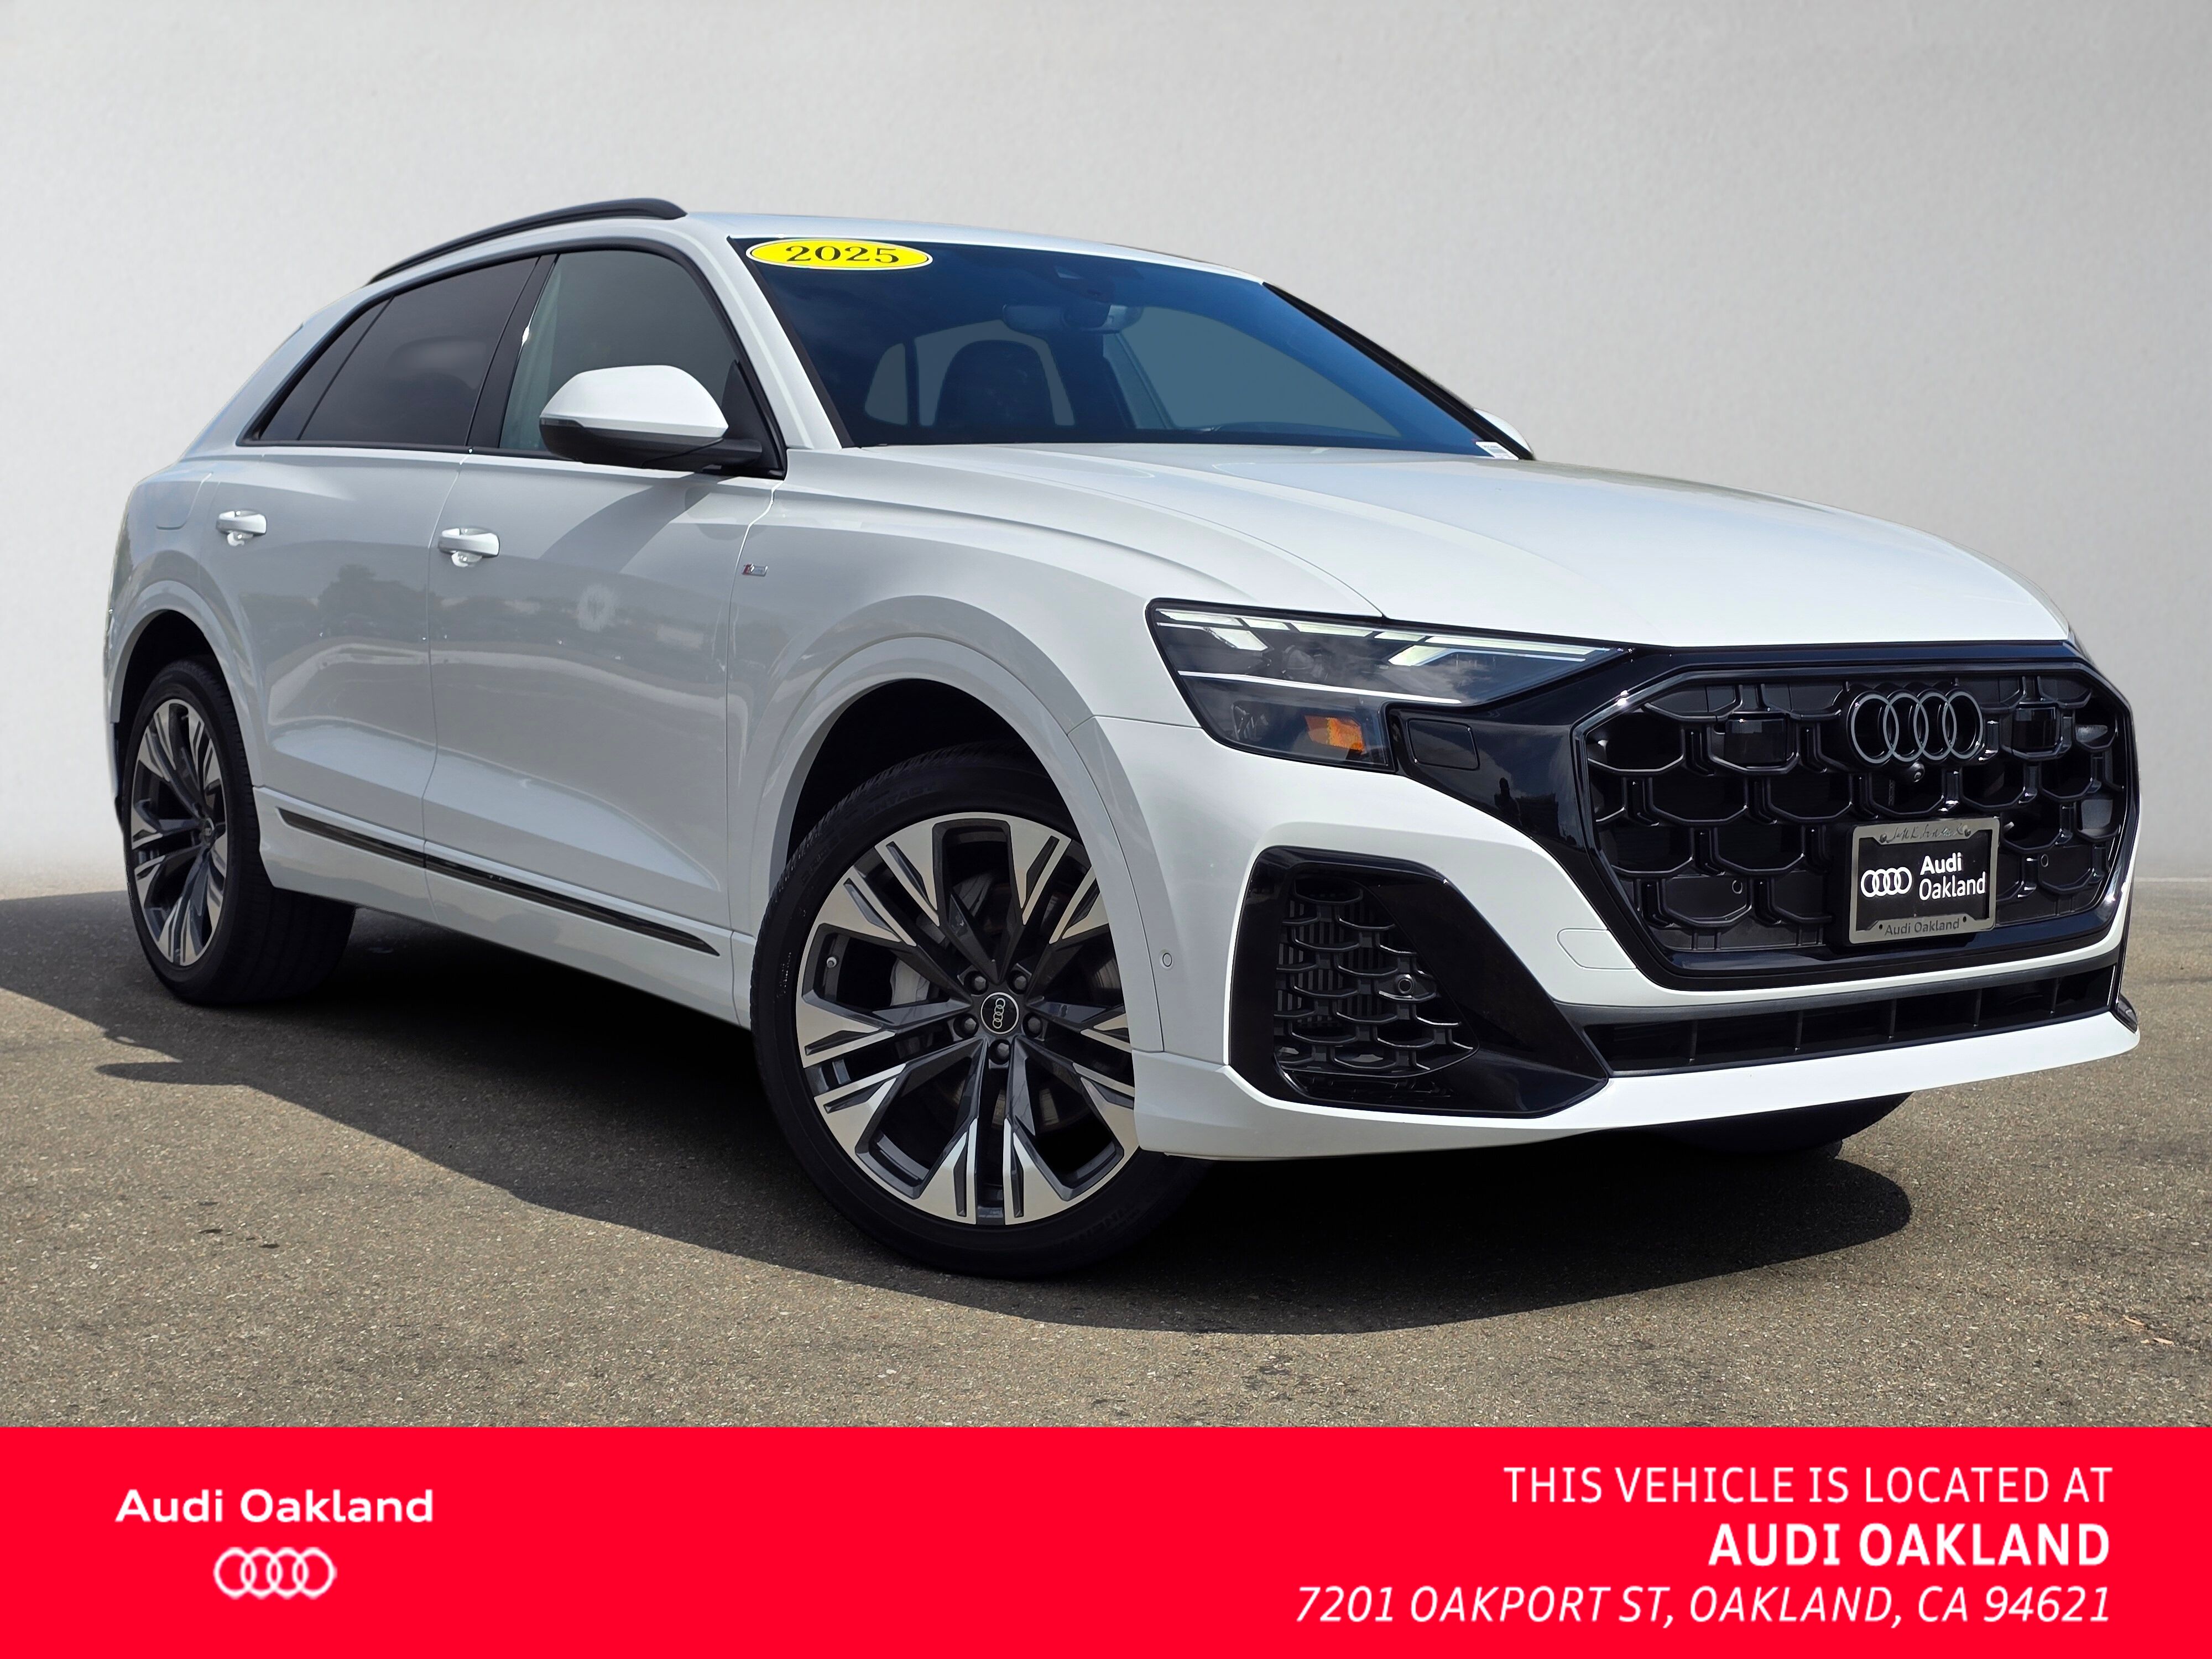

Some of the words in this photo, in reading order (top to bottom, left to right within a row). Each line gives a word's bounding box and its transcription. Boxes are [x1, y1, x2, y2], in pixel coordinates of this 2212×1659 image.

[786, 246, 899, 263] 2025
[1919, 852, 1962, 875] Audi
[1919, 871, 1986, 900] Oakland
[1885, 923, 1911, 936] Audi
[1914, 918, 1959, 932] Oakland
